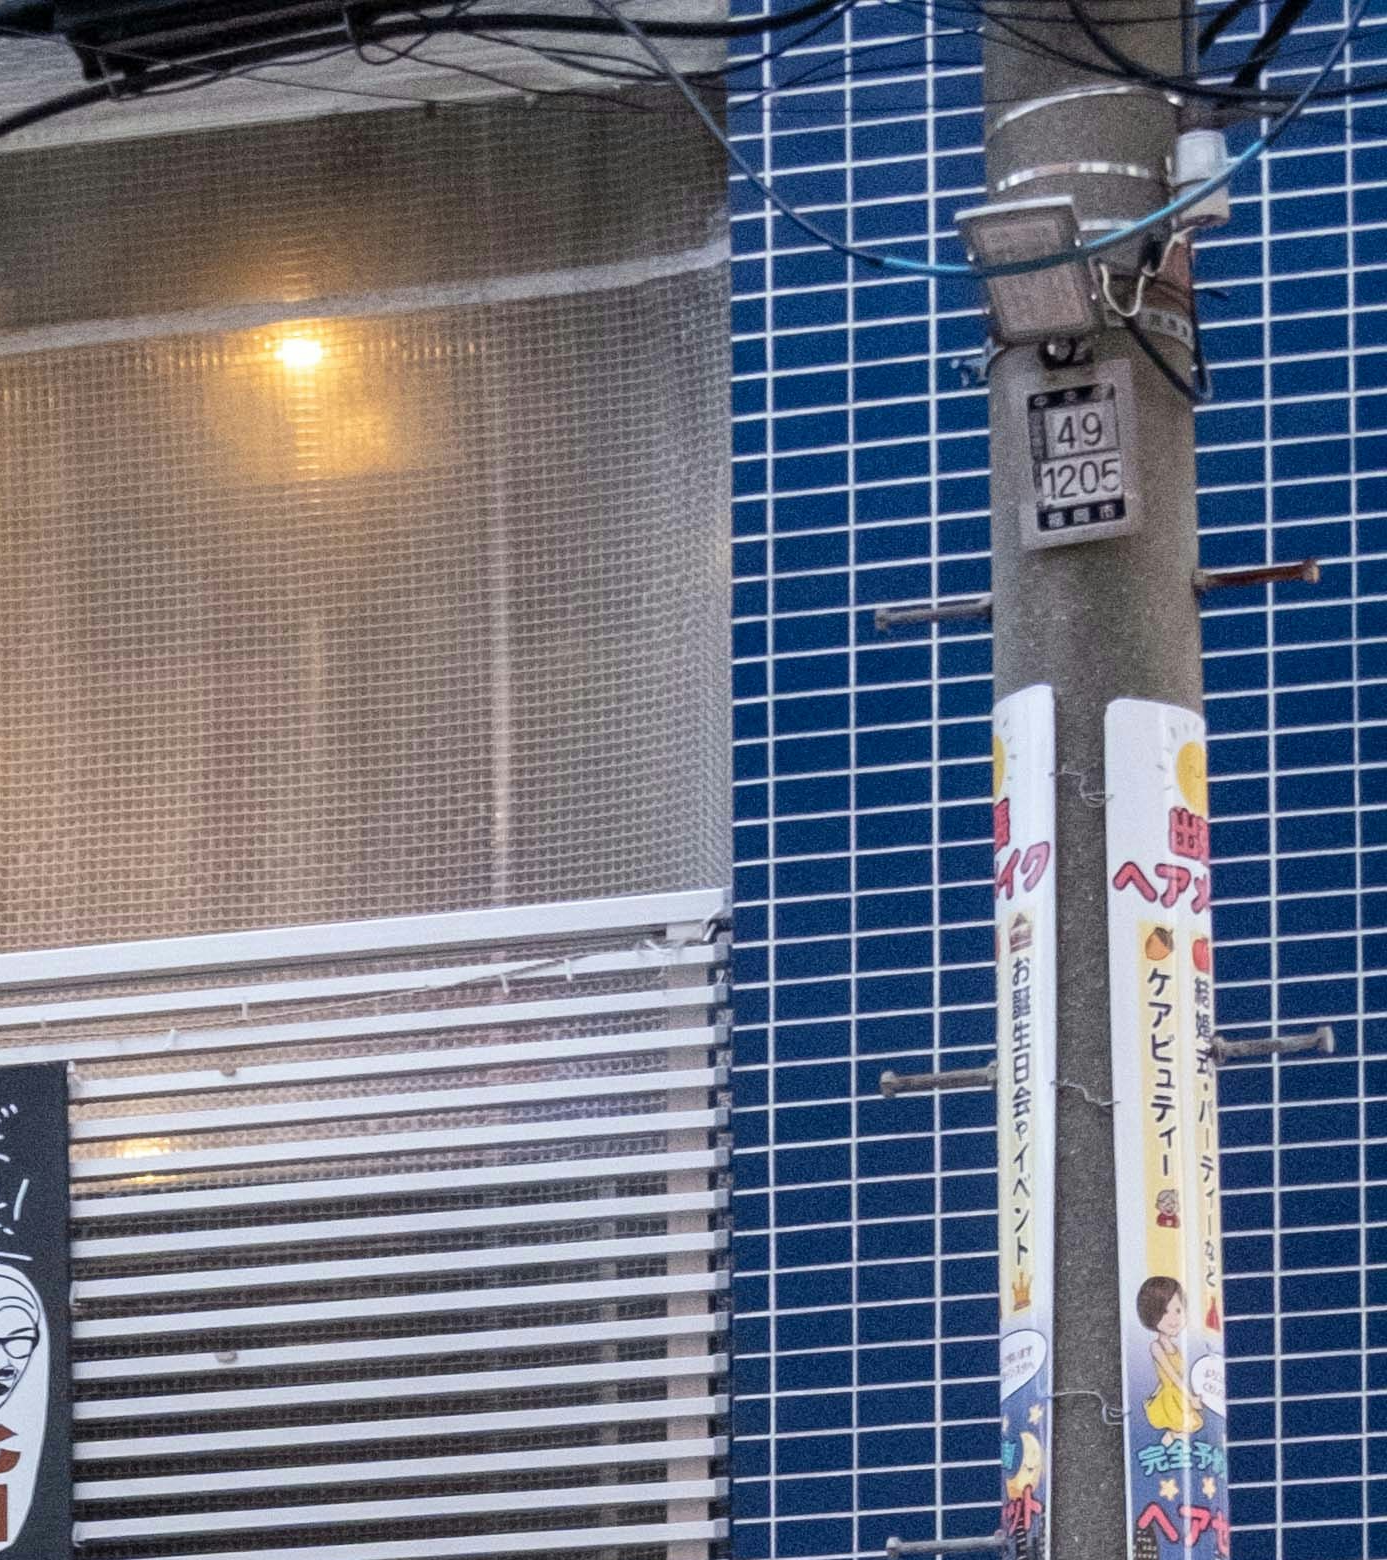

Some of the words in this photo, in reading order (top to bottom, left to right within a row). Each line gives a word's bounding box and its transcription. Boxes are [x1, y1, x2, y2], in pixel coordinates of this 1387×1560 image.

[1057, 411, 1104, 450] 49
[1042, 458, 1120, 501] 1205
[1145, 966, 1178, 1178] ケアビュティー
